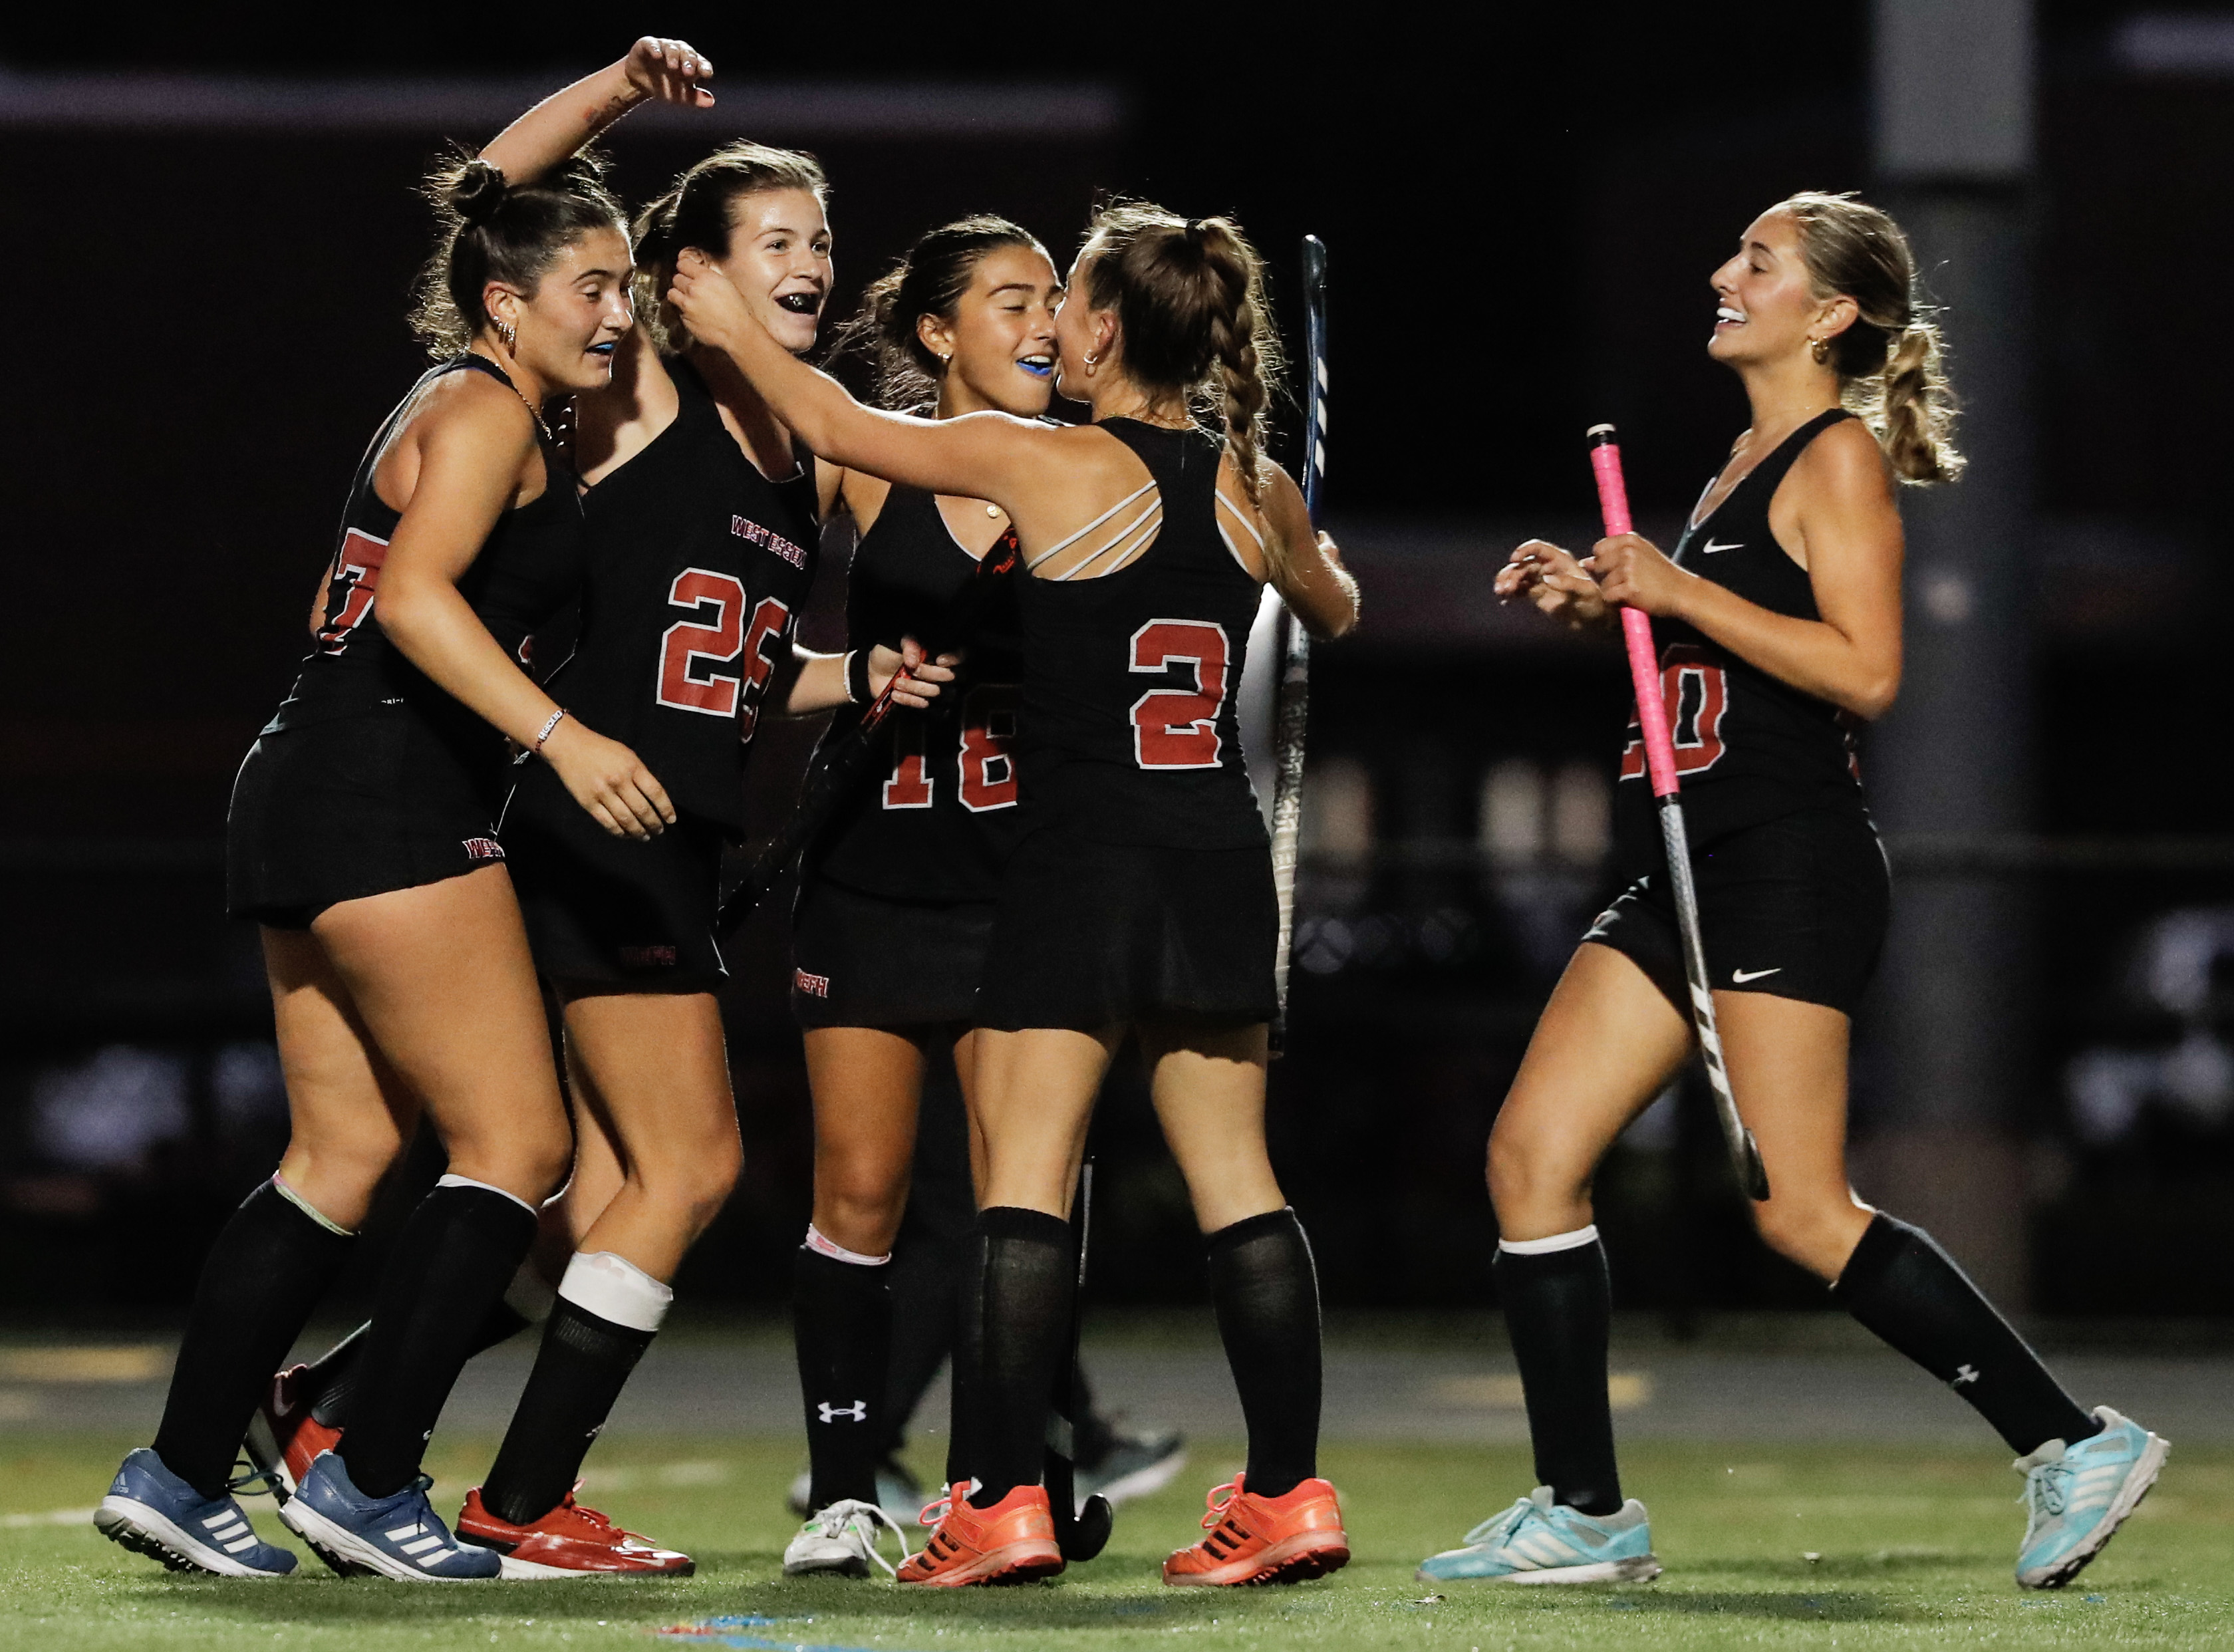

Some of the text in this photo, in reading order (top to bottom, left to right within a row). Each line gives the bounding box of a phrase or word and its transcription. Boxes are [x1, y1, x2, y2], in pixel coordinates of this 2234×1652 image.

[731, 514, 807, 571] WEST ESSEX
[882, 682, 1024, 813] 18
[1128, 618, 1231, 770] 2
